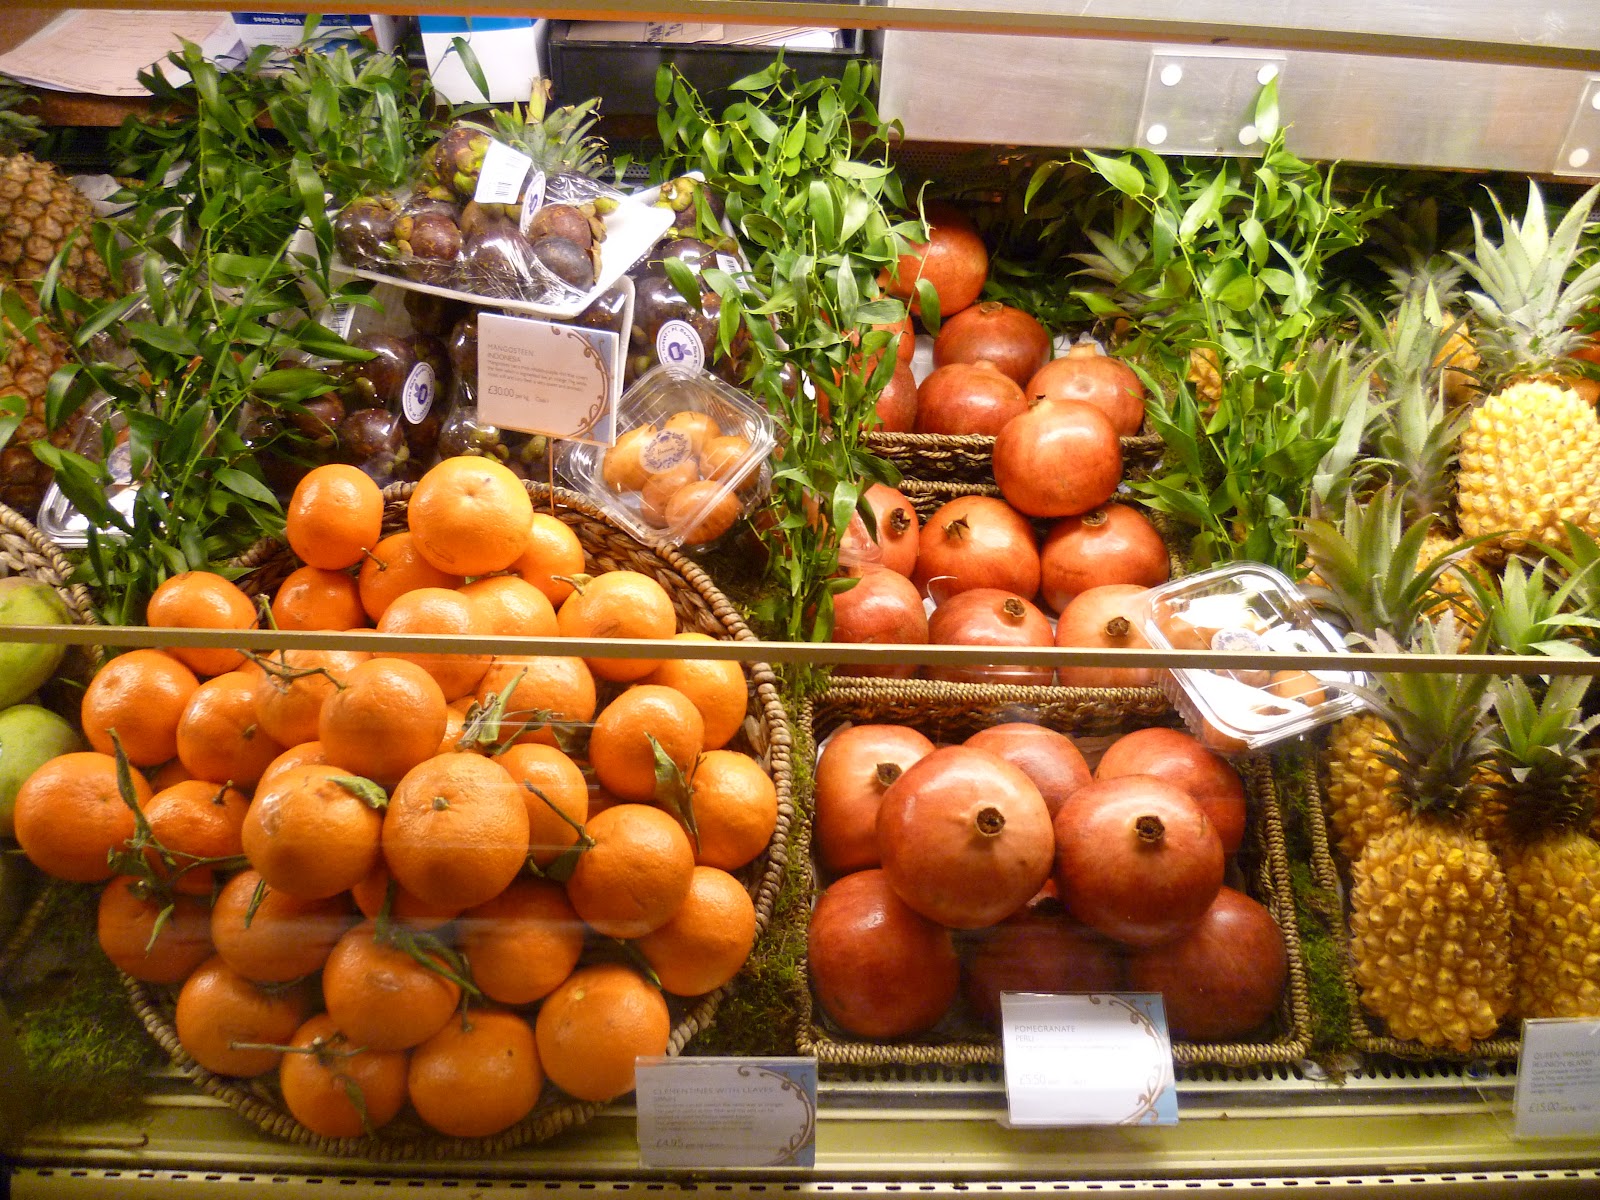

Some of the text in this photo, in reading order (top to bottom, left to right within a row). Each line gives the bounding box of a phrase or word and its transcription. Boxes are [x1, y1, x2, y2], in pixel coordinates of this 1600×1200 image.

[487, 343, 534, 357] MANGOSTEEN
[487, 352, 521, 363] INDONESIA
[488, 385, 515, 398] £30.00
[1014, 1025, 1076, 1033] POMEGRANATE
[653, 1087, 715, 1095] CLEMENTINES
[742, 1086, 774, 1094] LEAVES
